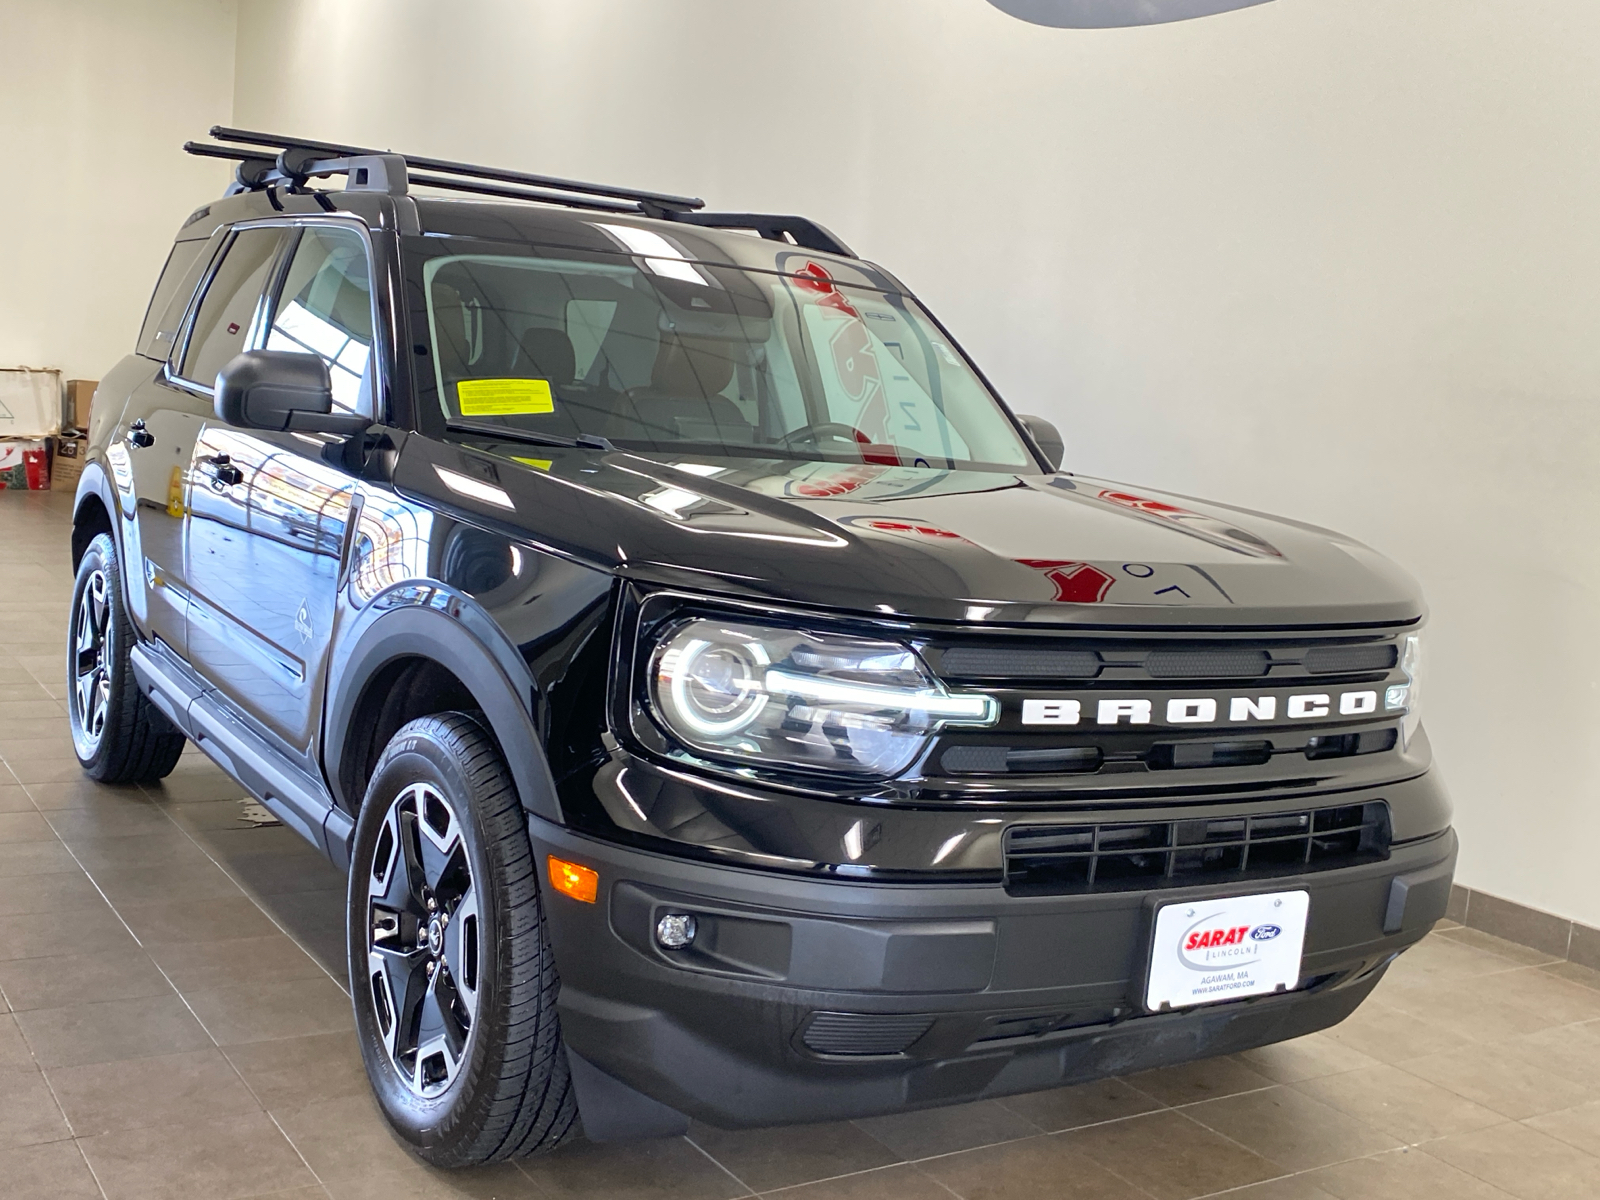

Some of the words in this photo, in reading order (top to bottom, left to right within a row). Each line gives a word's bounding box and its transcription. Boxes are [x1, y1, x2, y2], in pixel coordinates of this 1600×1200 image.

[1022, 690, 1376, 725] BRONCO
[1185, 925, 1250, 951] SARAT
[1253, 926, 1278, 940] Ford
[1212, 946, 1251, 958] LINCOLN
[1201, 972, 1235, 985] AGAWAM,
[1237, 971, 1249, 979] MA
[1192, 980, 1255, 995] WWW.SARATFORD.COM
